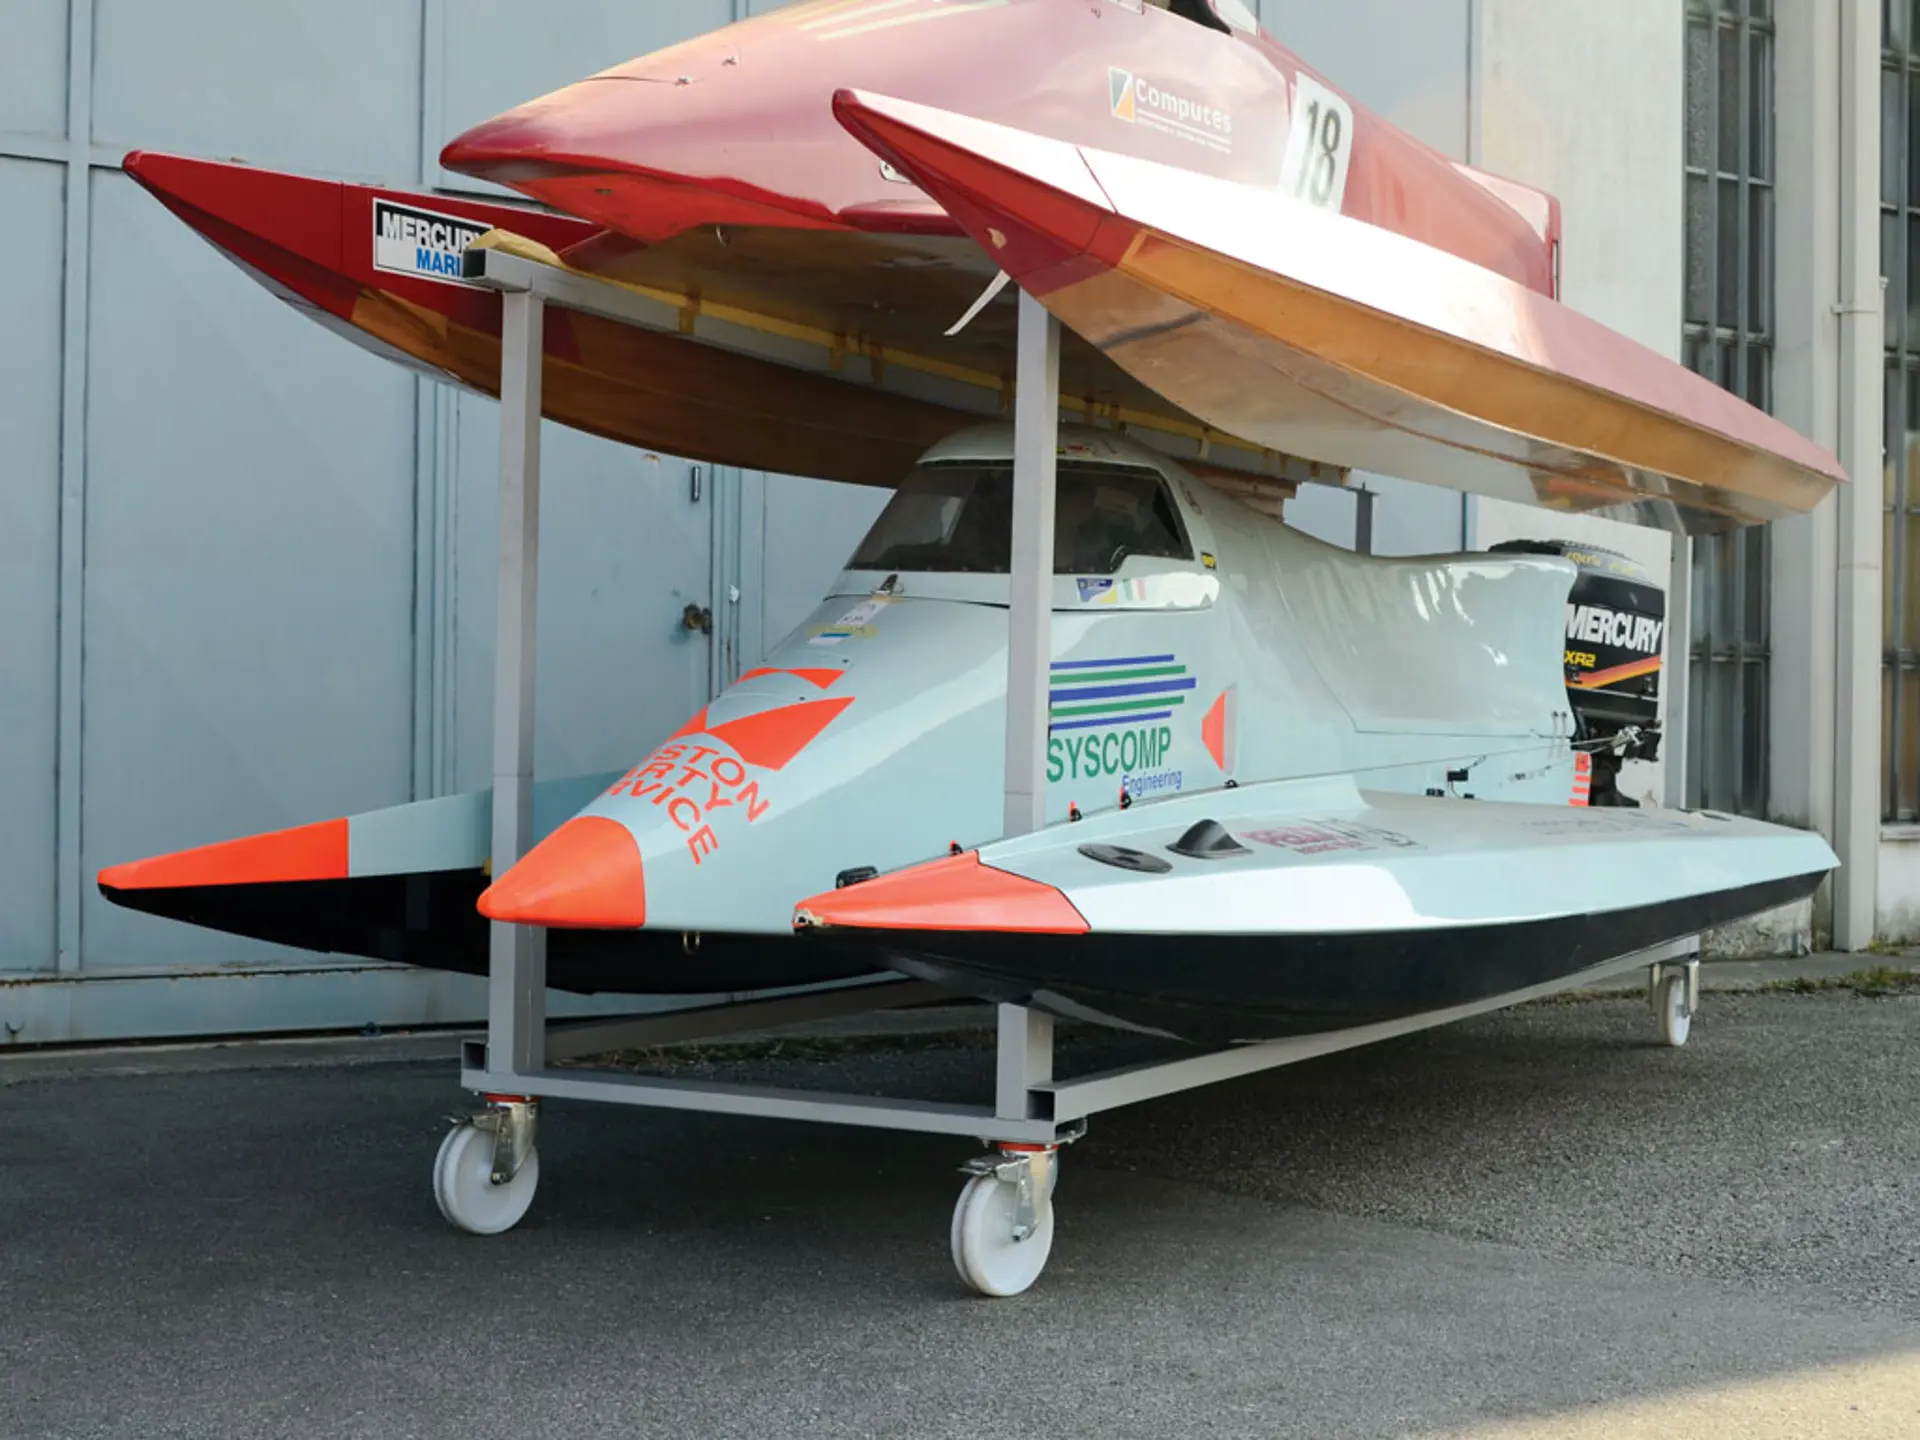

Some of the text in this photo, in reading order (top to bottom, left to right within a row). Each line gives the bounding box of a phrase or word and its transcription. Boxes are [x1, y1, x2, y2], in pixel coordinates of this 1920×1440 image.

[1135, 78, 1232, 133] Computes
[1294, 99, 1342, 206] 18
[382, 211, 481, 253] MERCUR
[416, 247, 461, 278] MARI
[1565, 604, 1662, 654] MERCURY
[1564, 650, 1597, 668] XR2
[1046, 726, 1171, 783] SYSCOMP
[644, 744, 771, 822] STON
[1122, 769, 1182, 797] Engineering
